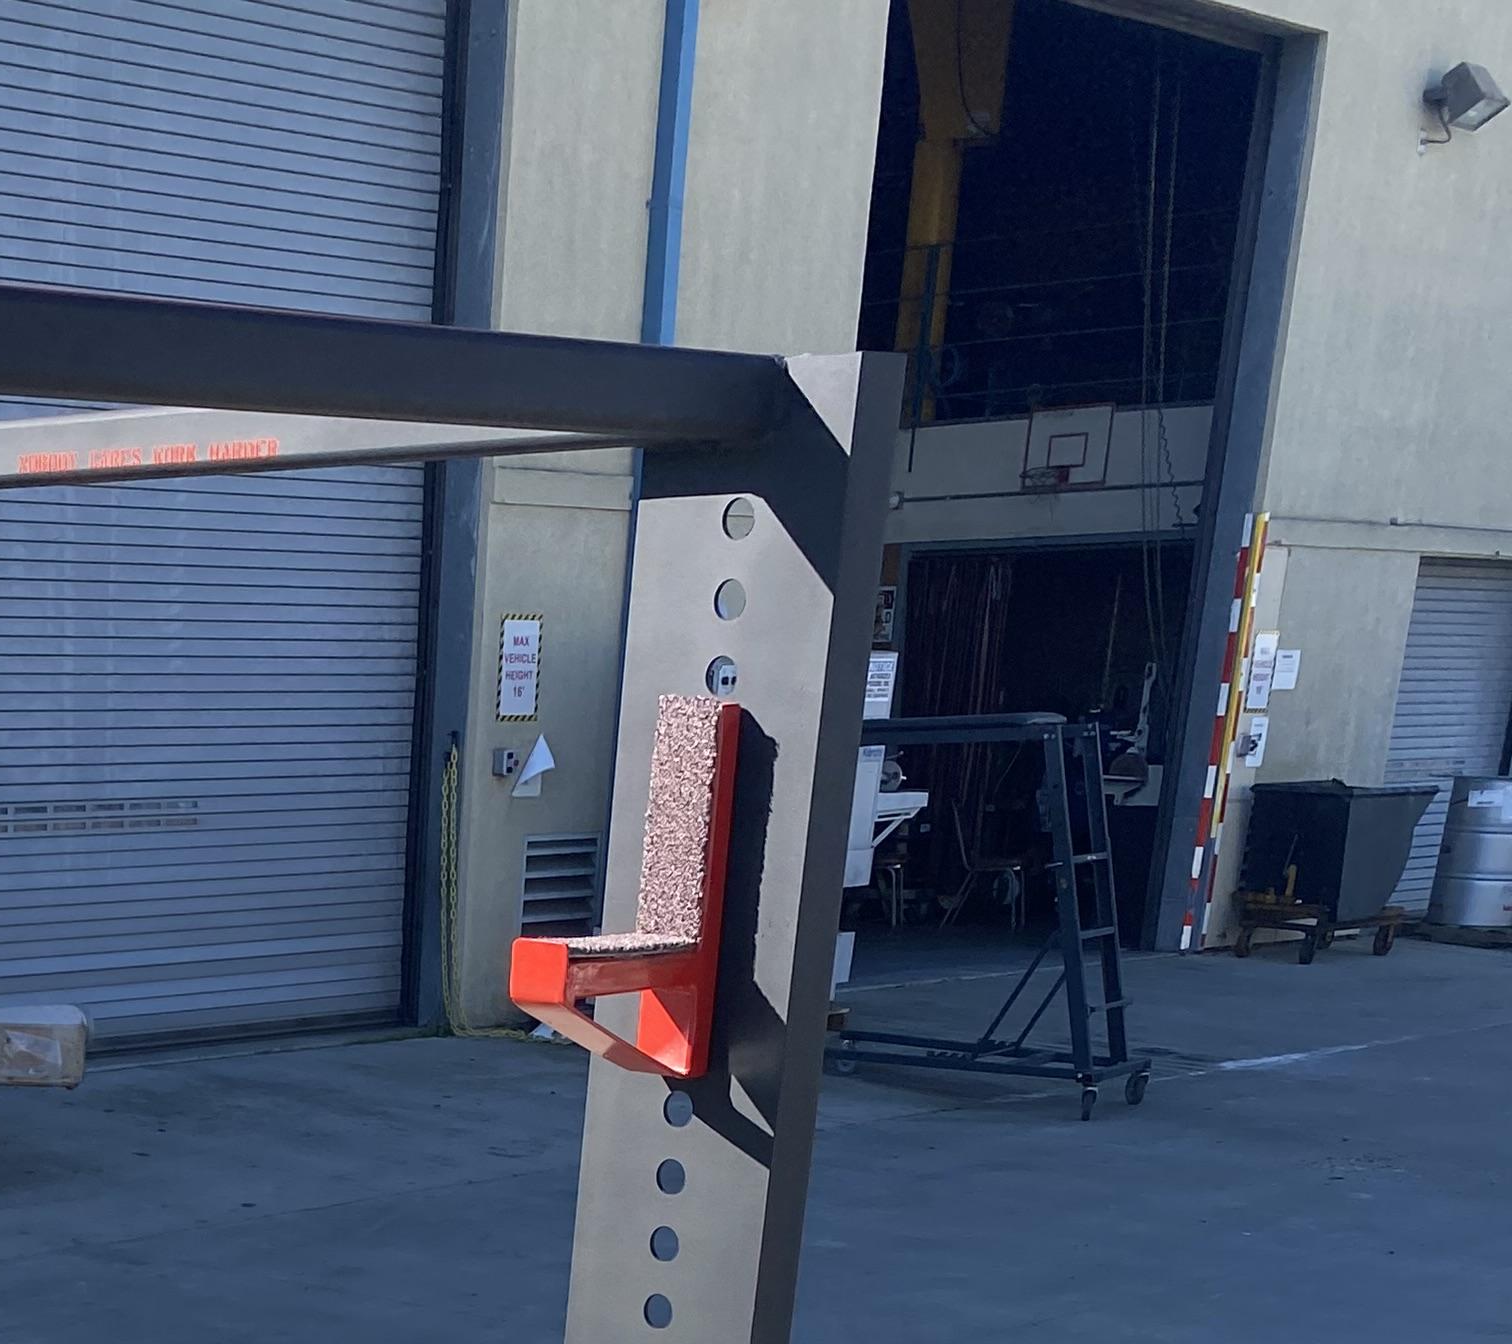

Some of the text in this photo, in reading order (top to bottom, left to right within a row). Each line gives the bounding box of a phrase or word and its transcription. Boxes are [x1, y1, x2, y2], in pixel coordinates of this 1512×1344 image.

[89, 448, 141, 468] CARES
[153, 444, 196, 464] WORK
[208, 439, 278, 461] HARDER
[513, 635, 529, 646] MAX
[504, 653, 537, 664] VEHICLE
[505, 670, 533, 680] HEIGHT
